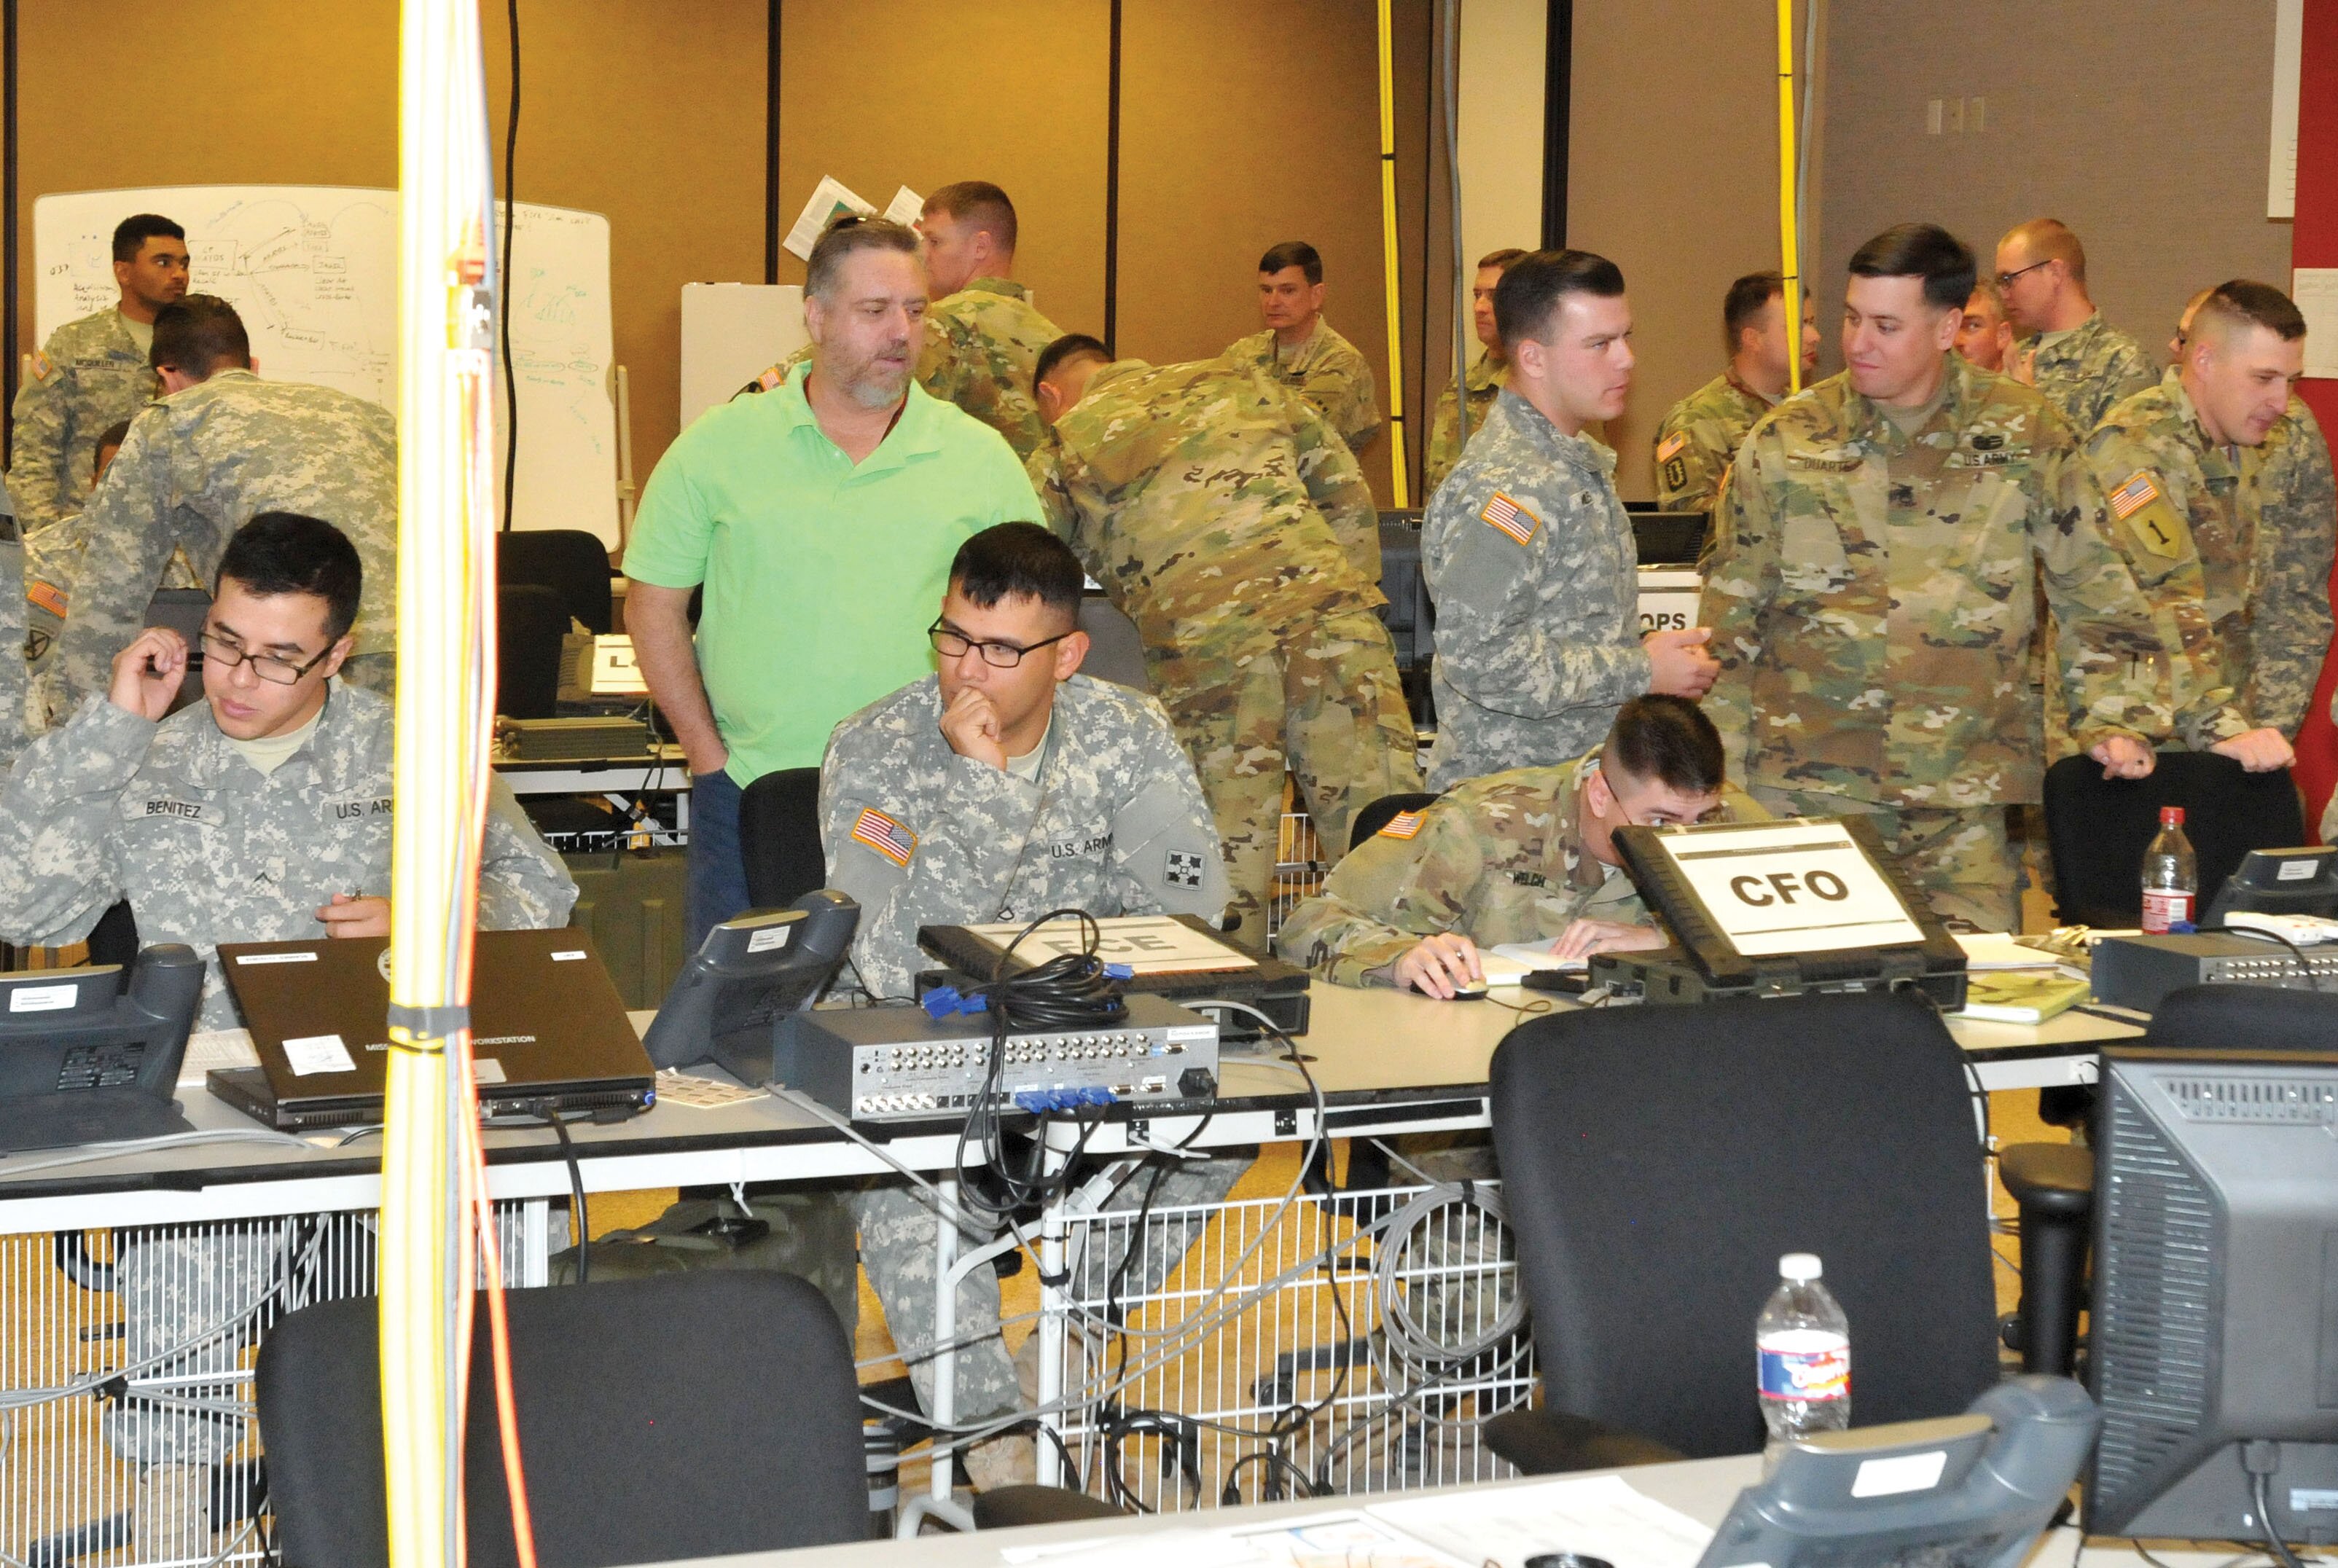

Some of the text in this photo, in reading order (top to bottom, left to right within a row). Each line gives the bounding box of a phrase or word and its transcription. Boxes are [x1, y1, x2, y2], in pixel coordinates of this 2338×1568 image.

[1805, 456, 1849, 473] DUART
[1640, 613, 1686, 631] OPS
[146, 801, 201, 819] BENITEZ
[336, 799, 394, 819] U.S. AR
[1051, 831, 1114, 858] U.S. ARM
[1730, 870, 1850, 907] CFO
